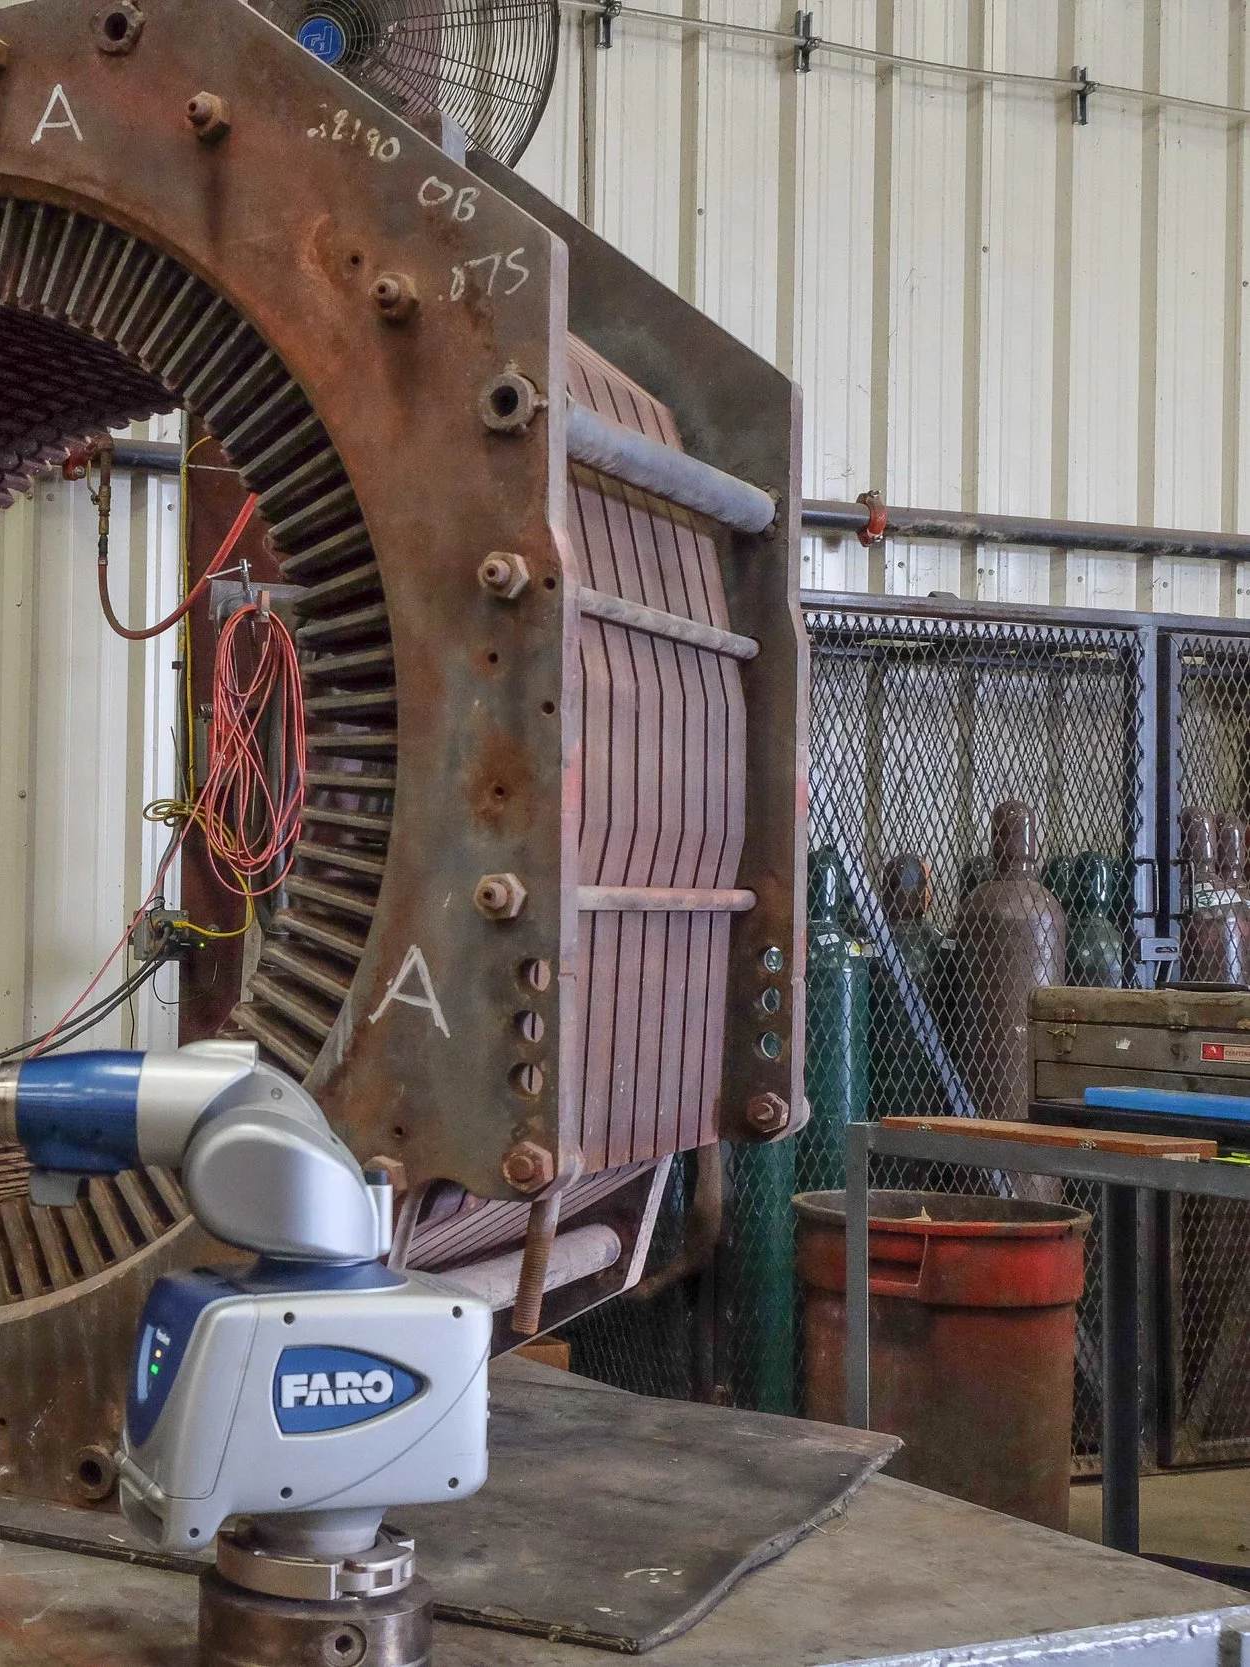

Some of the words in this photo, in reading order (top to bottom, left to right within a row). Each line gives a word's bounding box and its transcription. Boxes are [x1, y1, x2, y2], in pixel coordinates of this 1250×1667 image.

[31, 83, 83, 145] A
[368, 943, 451, 1038] A
[280, 1369, 394, 1409] FARO
